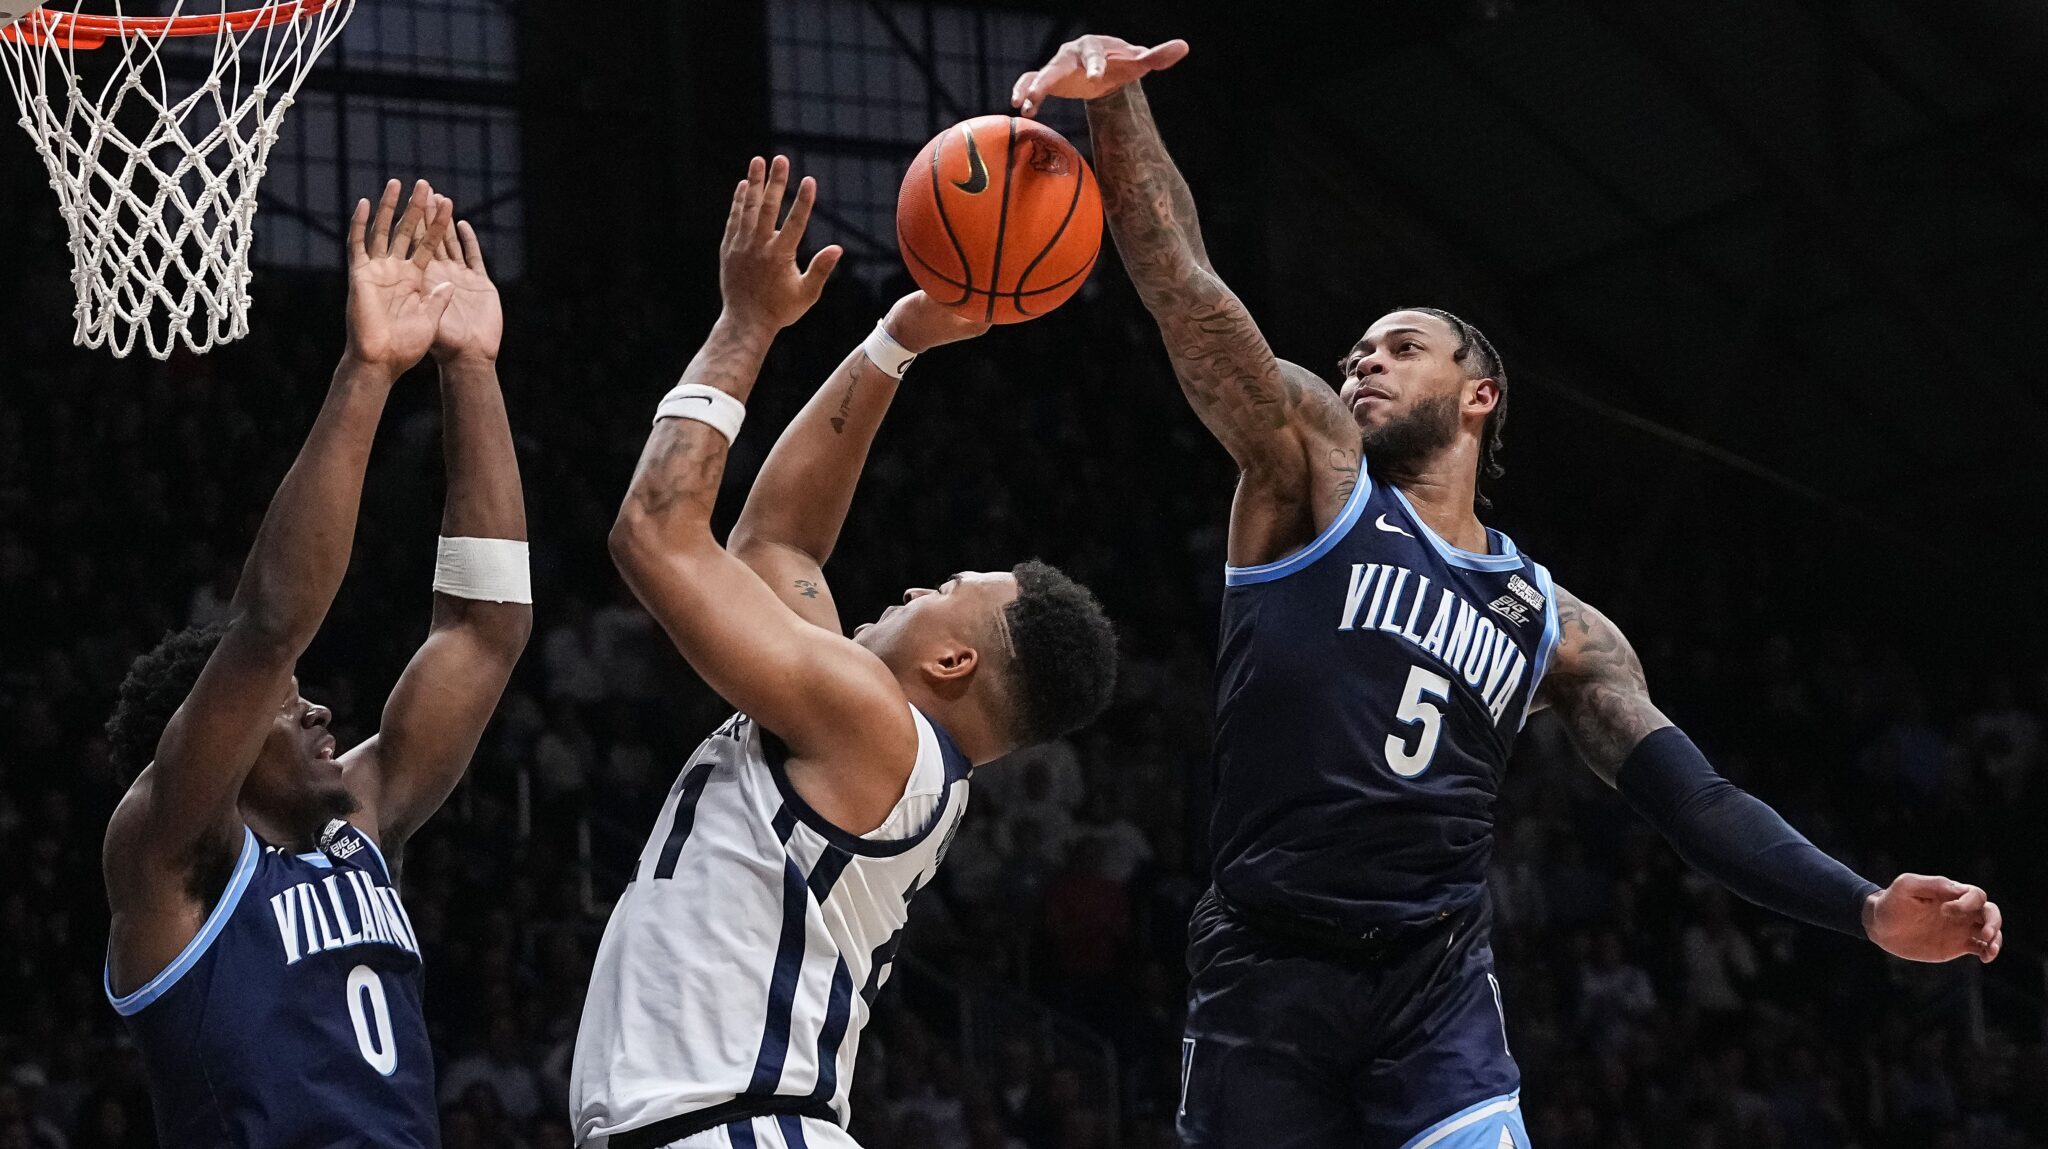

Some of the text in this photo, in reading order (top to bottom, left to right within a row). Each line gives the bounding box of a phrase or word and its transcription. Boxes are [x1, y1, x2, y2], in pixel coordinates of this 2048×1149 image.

[1499, 595, 1528, 614] BIG
[1507, 582, 1542, 611] CHANGE
[1490, 600, 1530, 624] EAST
[1338, 563, 1527, 728] VILLANOVA
[1384, 665, 1451, 779] 5
[330, 835, 350, 853] BIG
[334, 837, 360, 859] EAST
[346, 964, 398, 1077] 0
